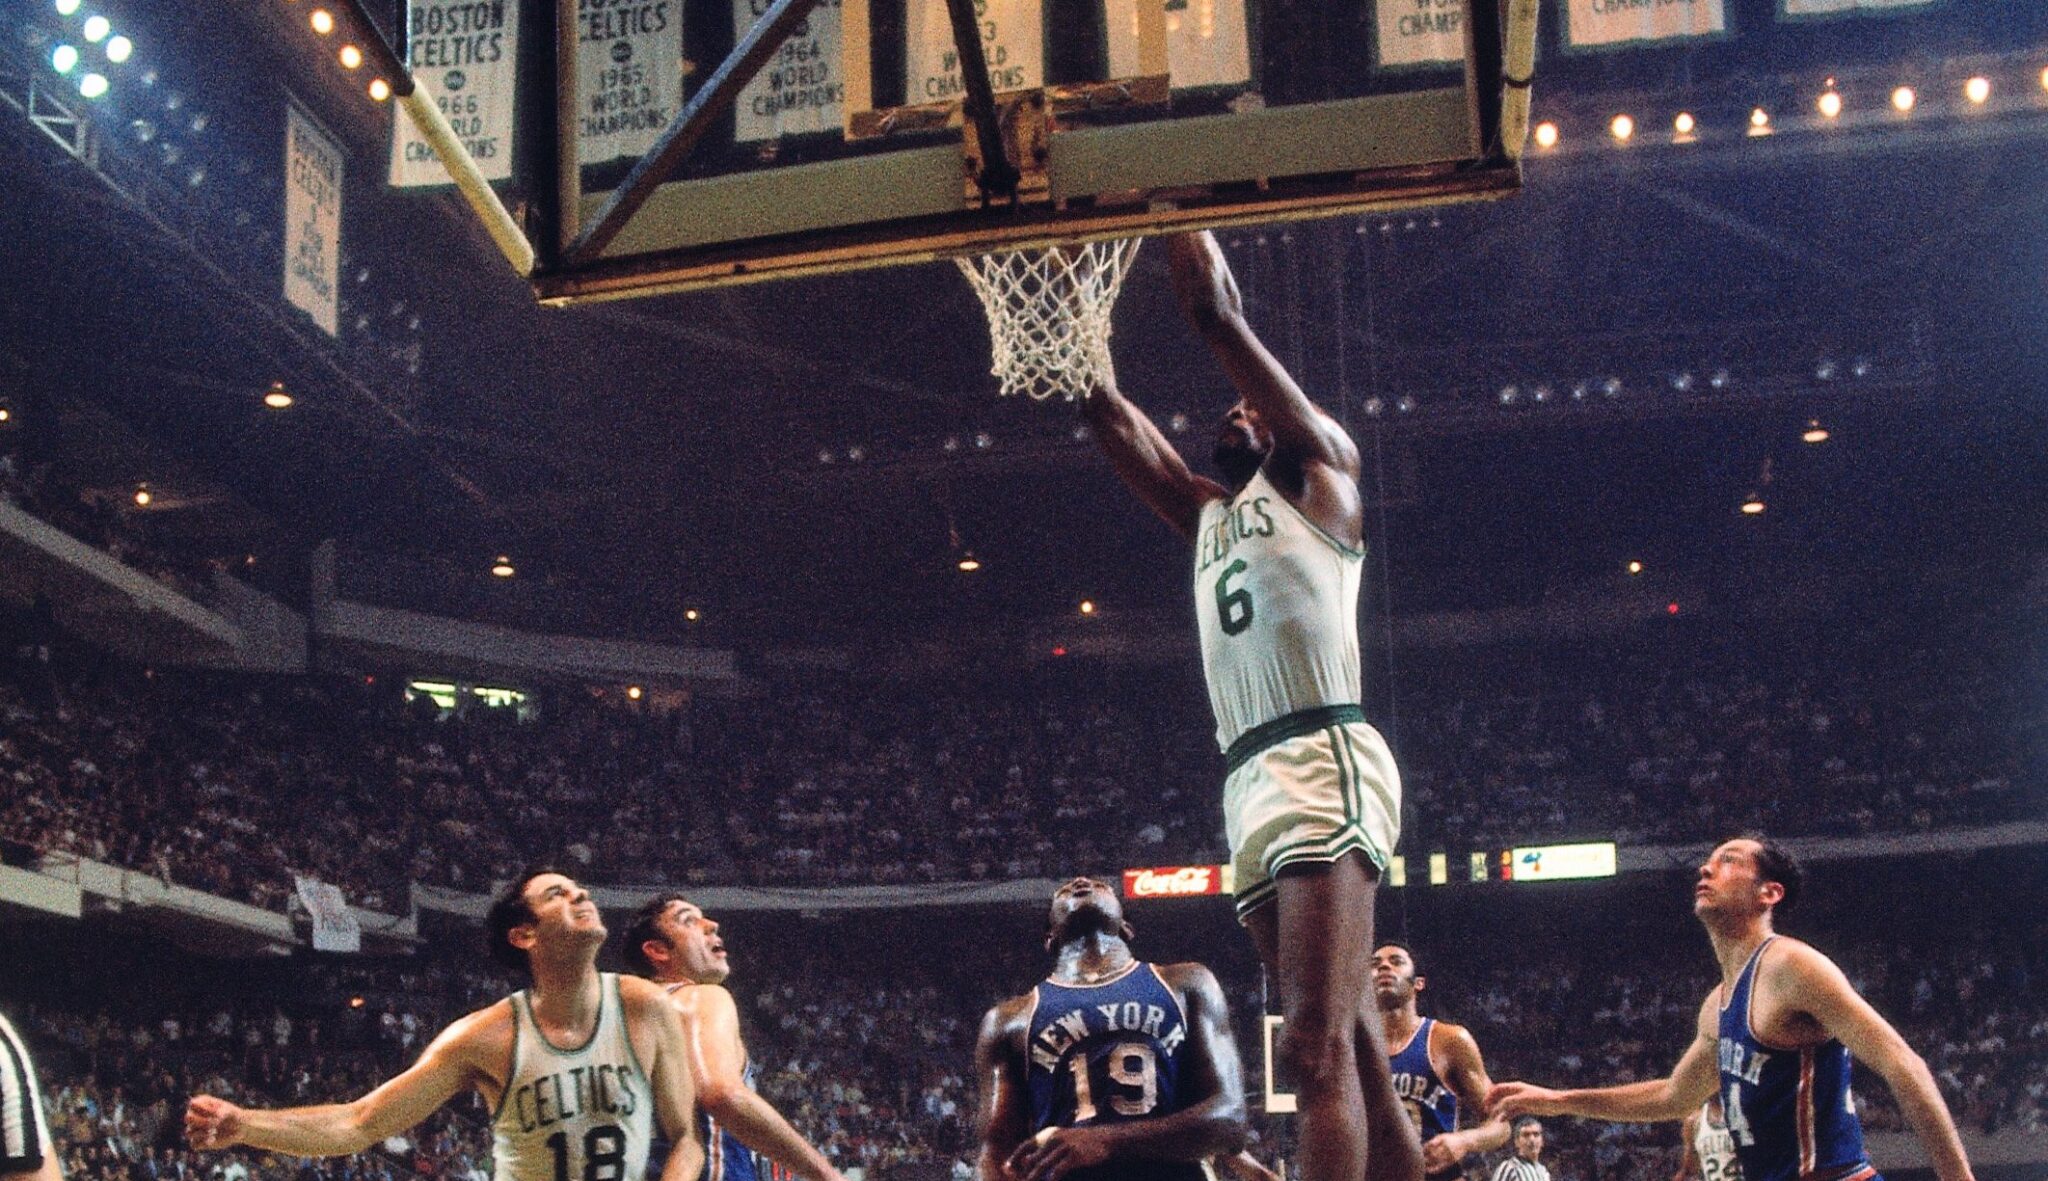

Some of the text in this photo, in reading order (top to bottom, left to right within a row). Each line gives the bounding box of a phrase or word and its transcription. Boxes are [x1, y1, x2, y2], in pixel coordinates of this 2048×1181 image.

[412, 1, 503, 35] BOSTON
[1399, 10, 1461, 36] CHAMP
[412, 32, 502, 67] CELTICS
[438, 95, 477, 114] 966
[452, 116, 481, 136] RLD
[1215, 558, 1254, 636] 6
[1032, 1001, 1186, 1074] NEW YORK
[1720, 1037, 1771, 1086] ORK
[515, 1063, 636, 1133] CELTICS
[1069, 1042, 1158, 1122] 19
[547, 1125, 627, 1181] 18
